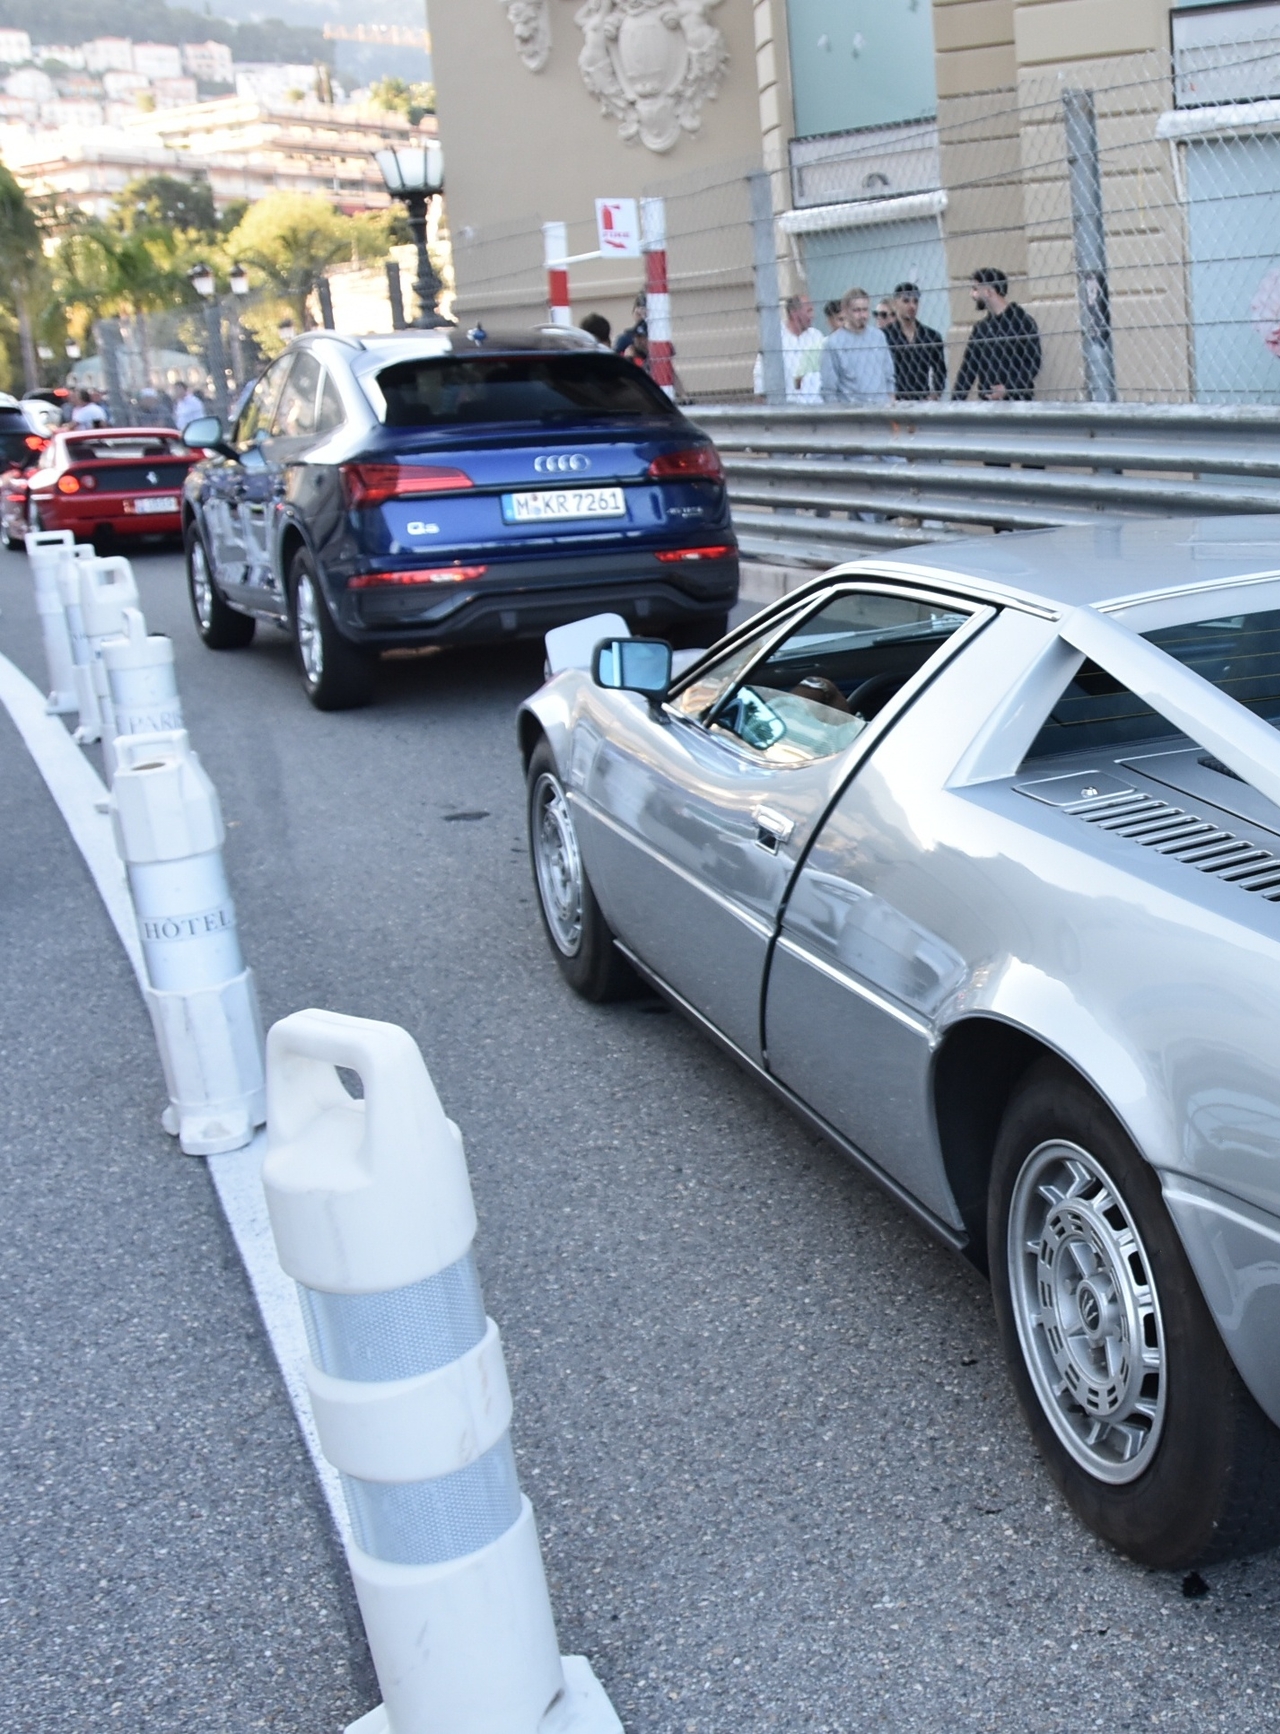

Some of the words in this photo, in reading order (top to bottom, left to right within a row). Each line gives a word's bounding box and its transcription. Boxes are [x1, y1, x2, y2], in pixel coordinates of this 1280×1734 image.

[516, 497, 530, 516] M
[542, 494, 569, 514] KR
[572, 491, 621, 512] 7261
